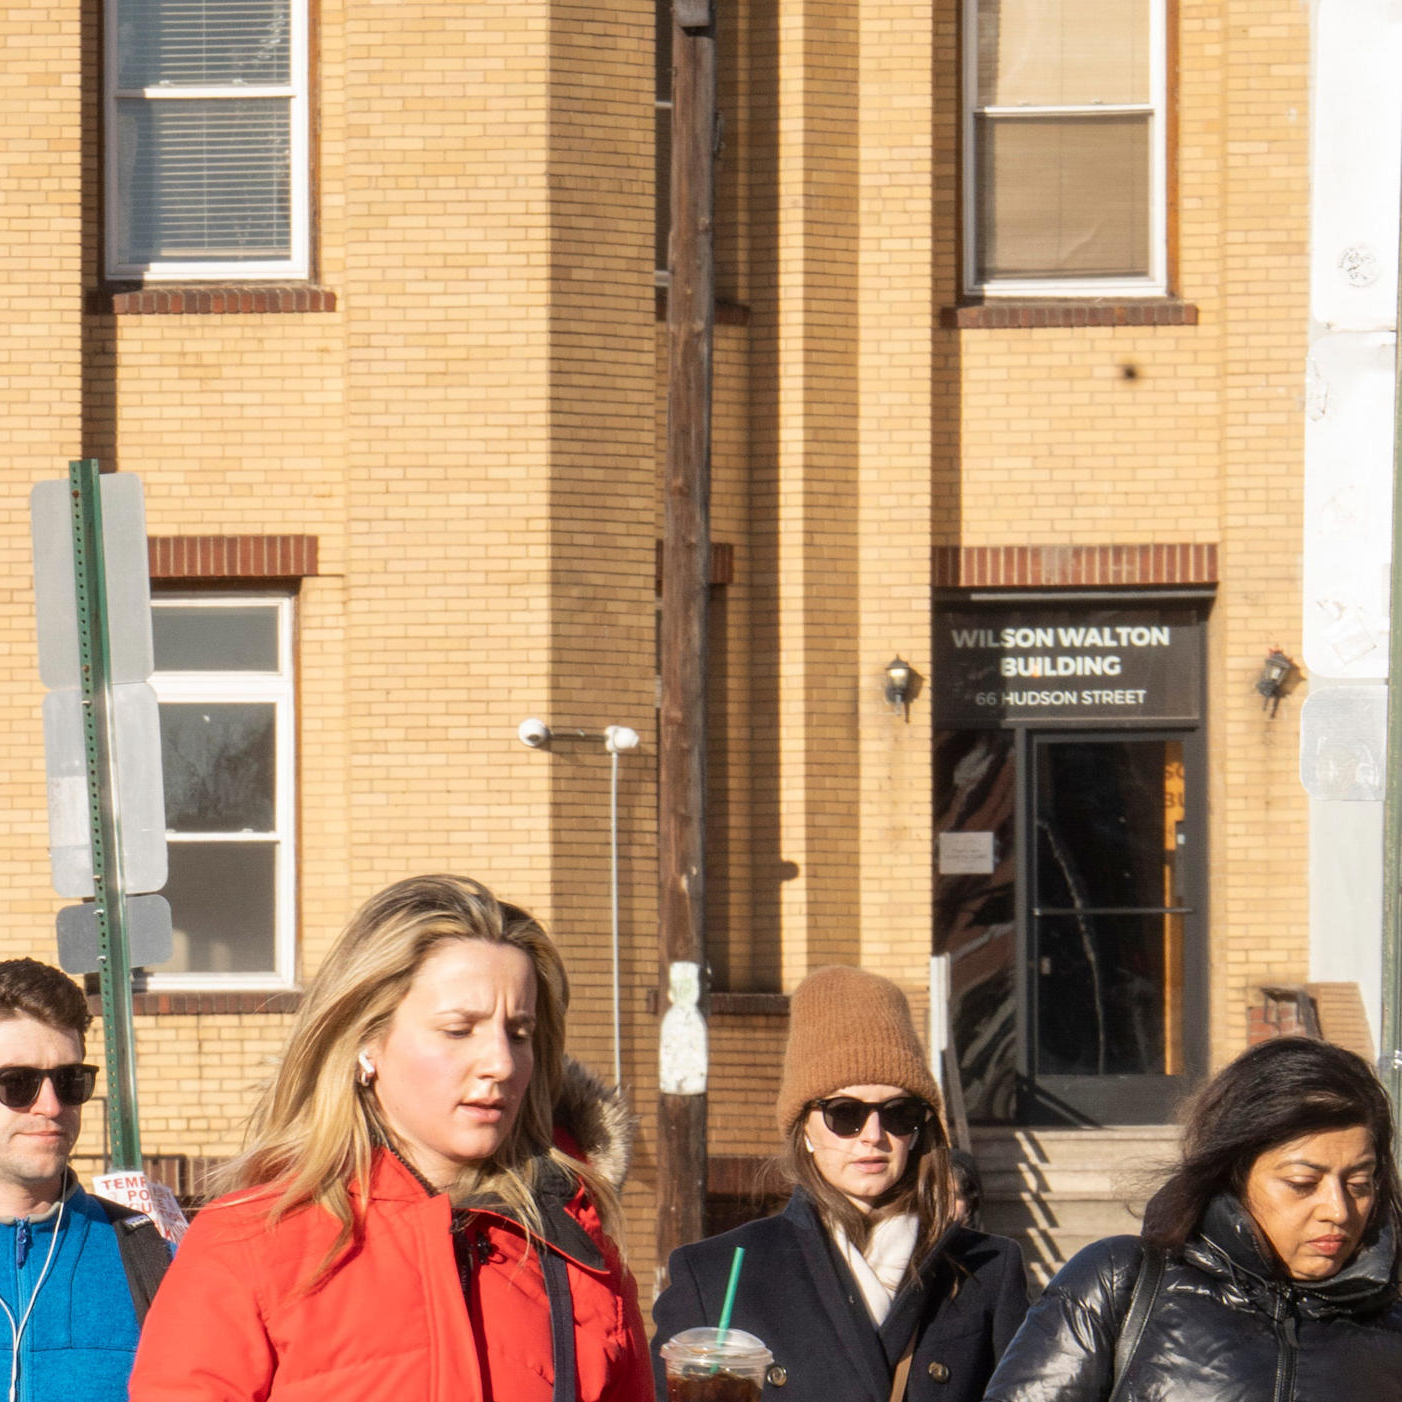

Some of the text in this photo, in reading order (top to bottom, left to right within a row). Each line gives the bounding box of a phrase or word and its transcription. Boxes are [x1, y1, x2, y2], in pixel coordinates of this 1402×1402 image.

[951, 626, 1171, 649] WILSON WALTON
[1000, 655, 1122, 678] BUILDING
[975, 689, 1147, 706] 66 HUDSON STREET
